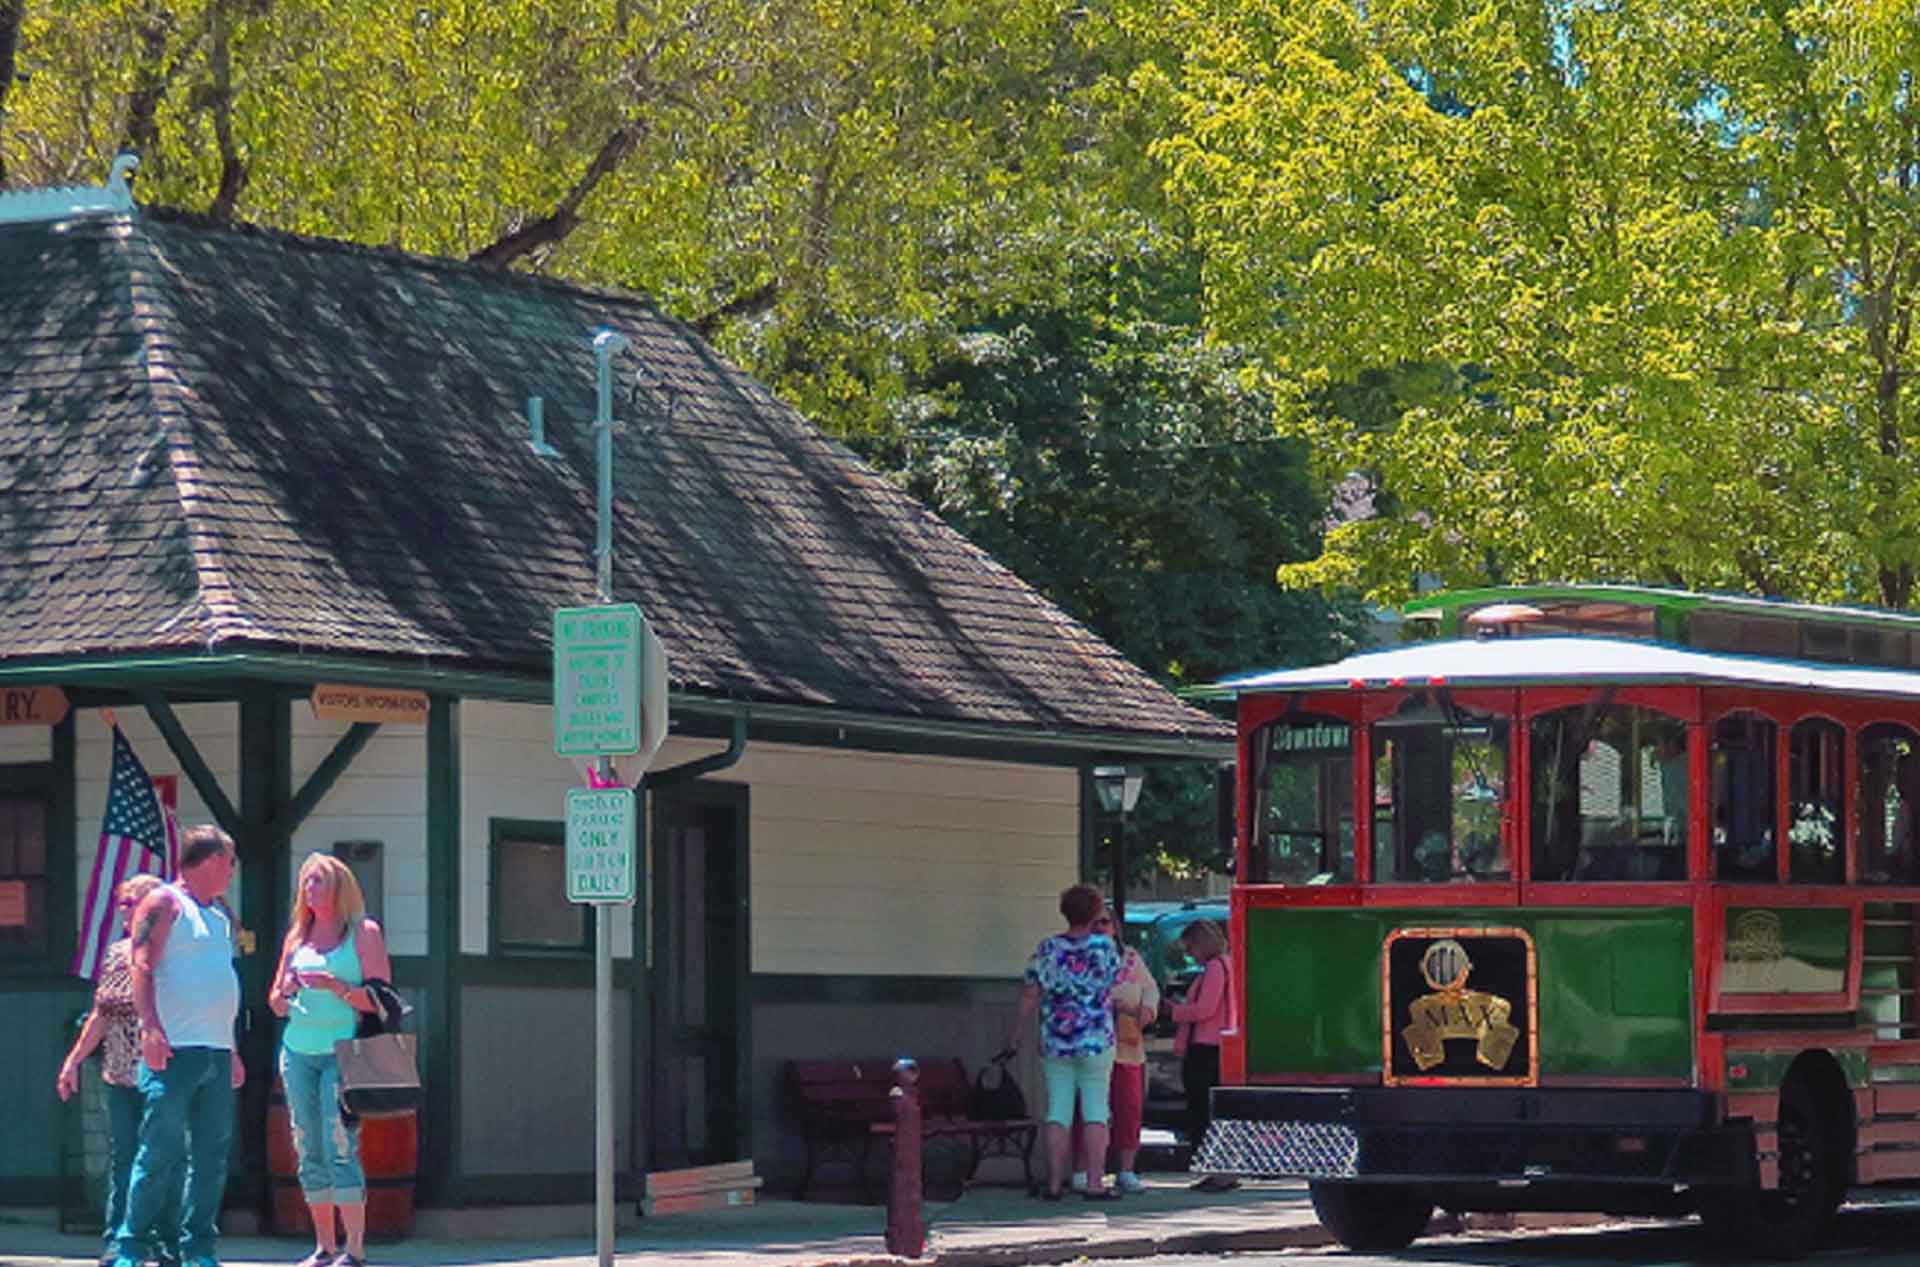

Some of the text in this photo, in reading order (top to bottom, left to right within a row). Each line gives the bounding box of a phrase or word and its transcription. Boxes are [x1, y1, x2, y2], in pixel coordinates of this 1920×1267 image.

[579, 831, 619, 848] ONLY
[578, 874, 620, 890] DAILY
[1423, 1001, 1496, 1031] MAX
